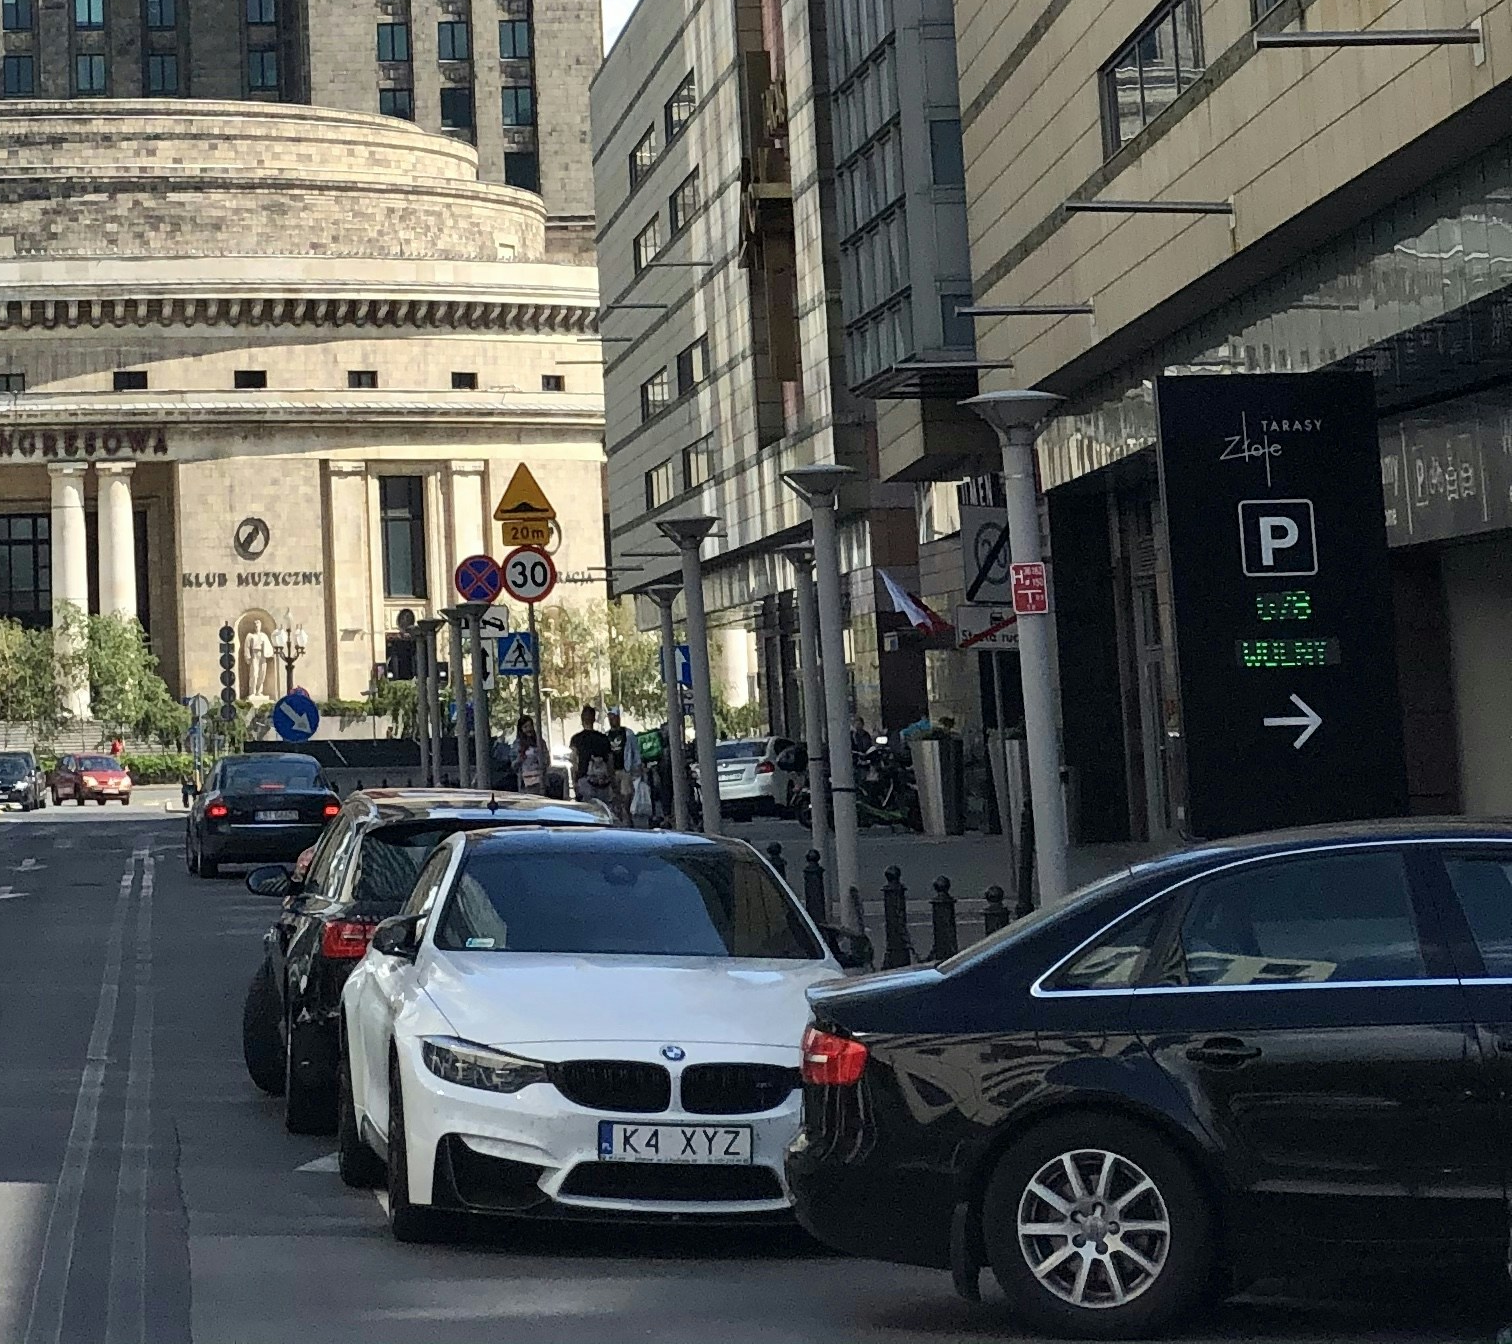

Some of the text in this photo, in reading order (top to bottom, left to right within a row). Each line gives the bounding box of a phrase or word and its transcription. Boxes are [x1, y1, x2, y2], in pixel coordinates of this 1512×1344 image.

[1260, 419, 1322, 432] TARASY
[1259, 516, 1299, 566] P
[182, 571, 322, 588] KLUB MUZYCZNY
[511, 561, 548, 589] 30
[623, 1127, 741, 1156] K4 XYZ
